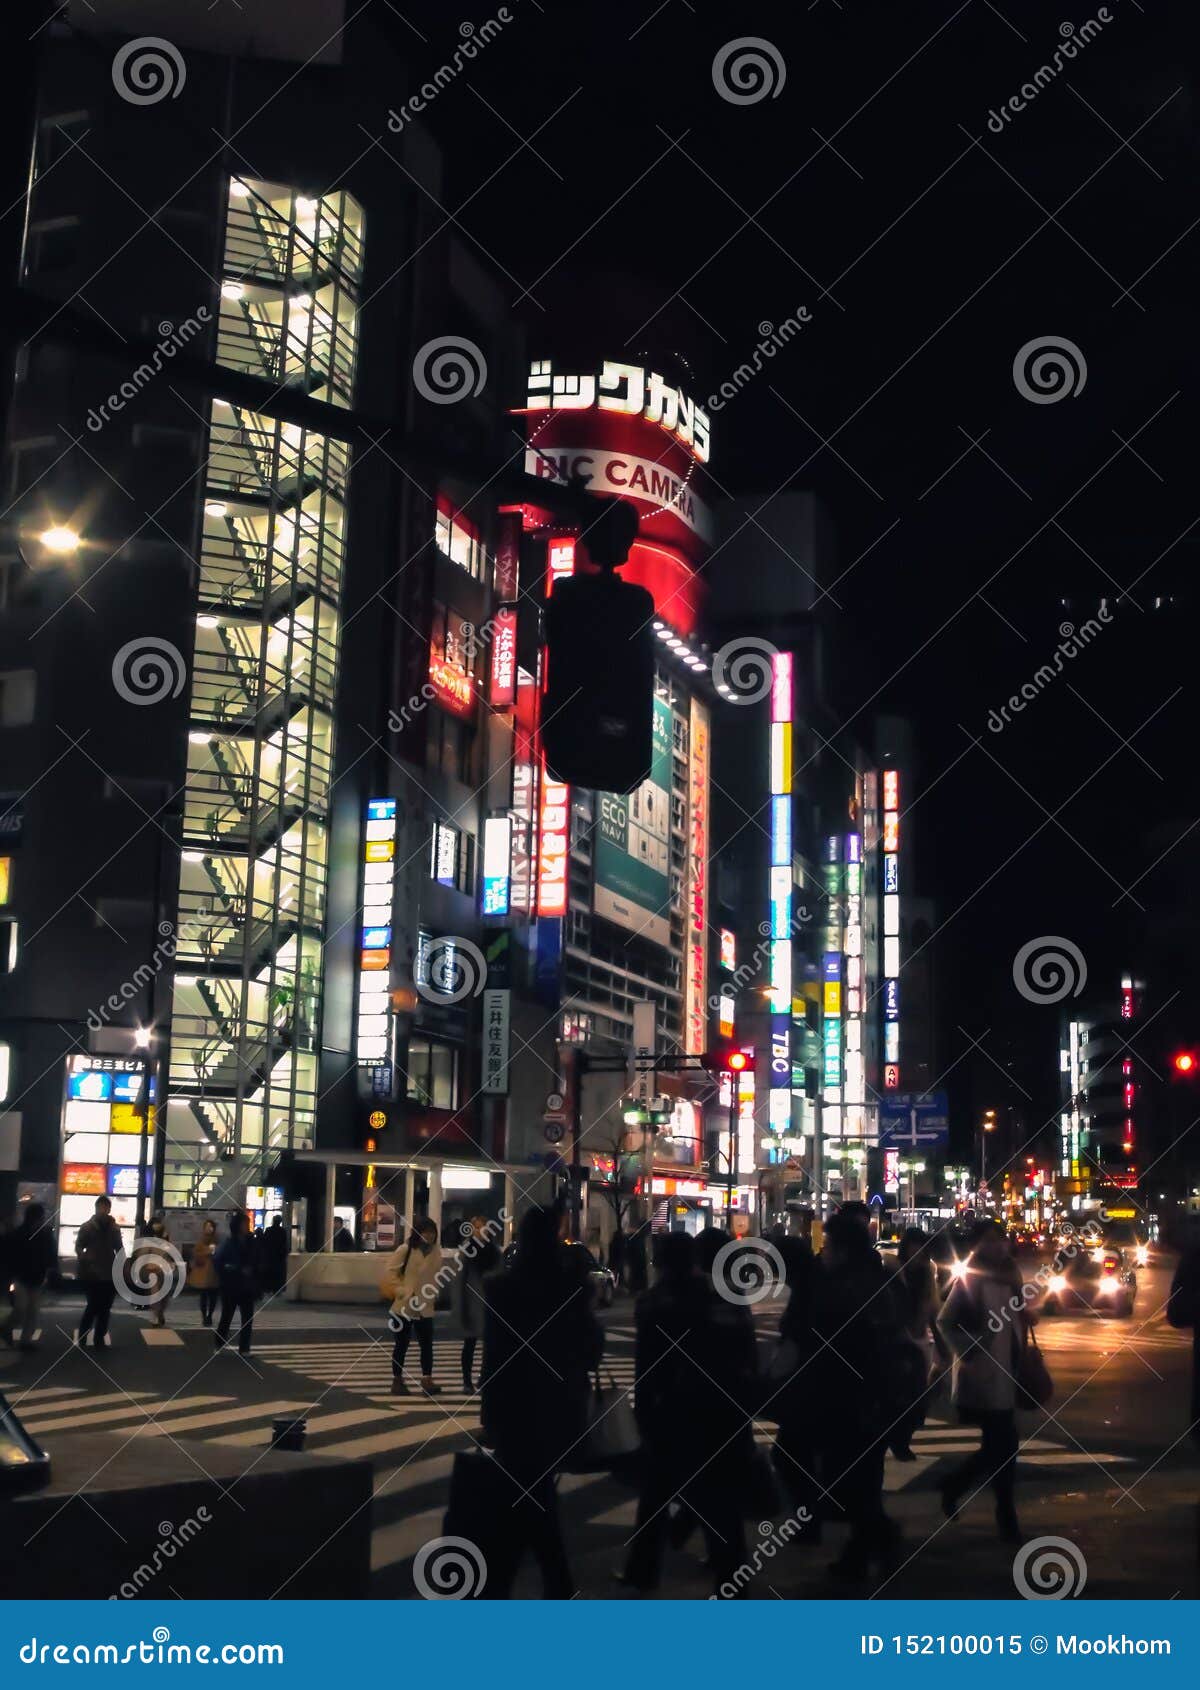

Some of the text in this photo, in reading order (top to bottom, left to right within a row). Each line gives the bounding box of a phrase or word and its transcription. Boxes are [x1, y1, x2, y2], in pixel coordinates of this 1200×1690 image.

[527, 360, 710, 462] ビックカメラ
[535, 455, 696, 524] BIC CAMERA
[601, 798, 625, 828] ECO
[602, 821, 625, 843] NAVI
[488, 995, 504, 1088] 三井住友銀行
[772, 1030, 789, 1073] TBC
